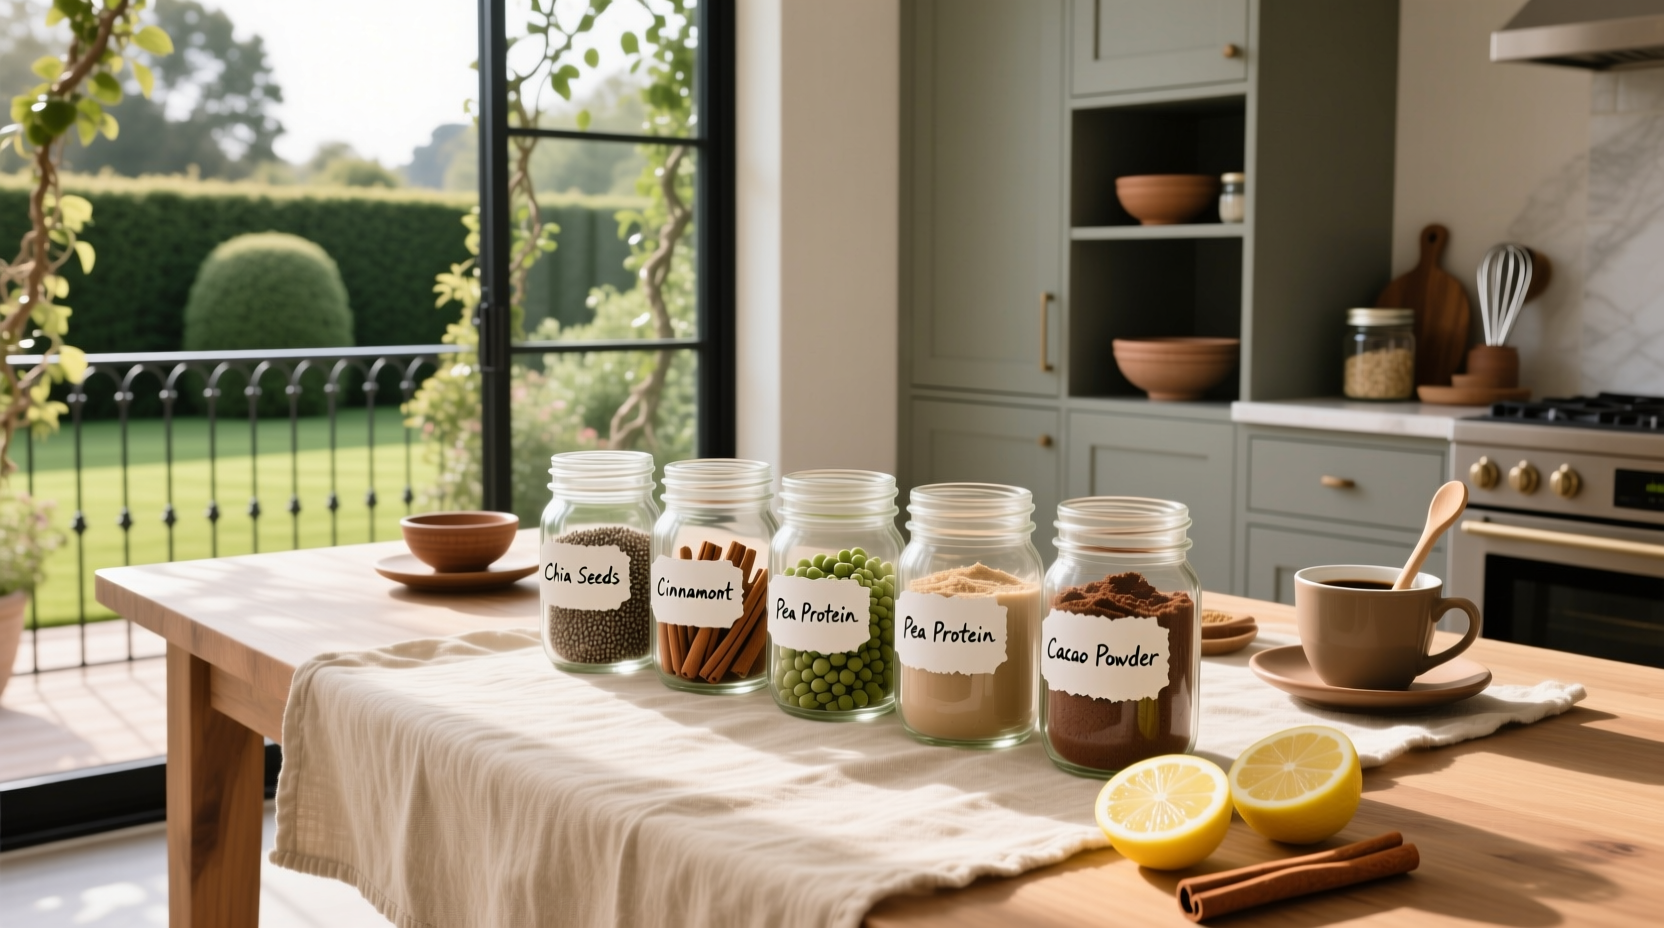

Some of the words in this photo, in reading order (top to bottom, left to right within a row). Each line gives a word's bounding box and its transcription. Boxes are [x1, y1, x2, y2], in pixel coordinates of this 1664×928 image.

[544, 562, 572, 584] Chia
[577, 566, 620, 585] Seeds
[657, 577, 734, 601] Cinnamont
[776, 597, 796, 621] Pea
[801, 602, 859, 623] Protein
[903, 615, 926, 639] Pea
[933, 621, 996, 643] Protein
[1047, 637, 1088, 663] Cacao
[1095, 643, 1159, 667] Powder
